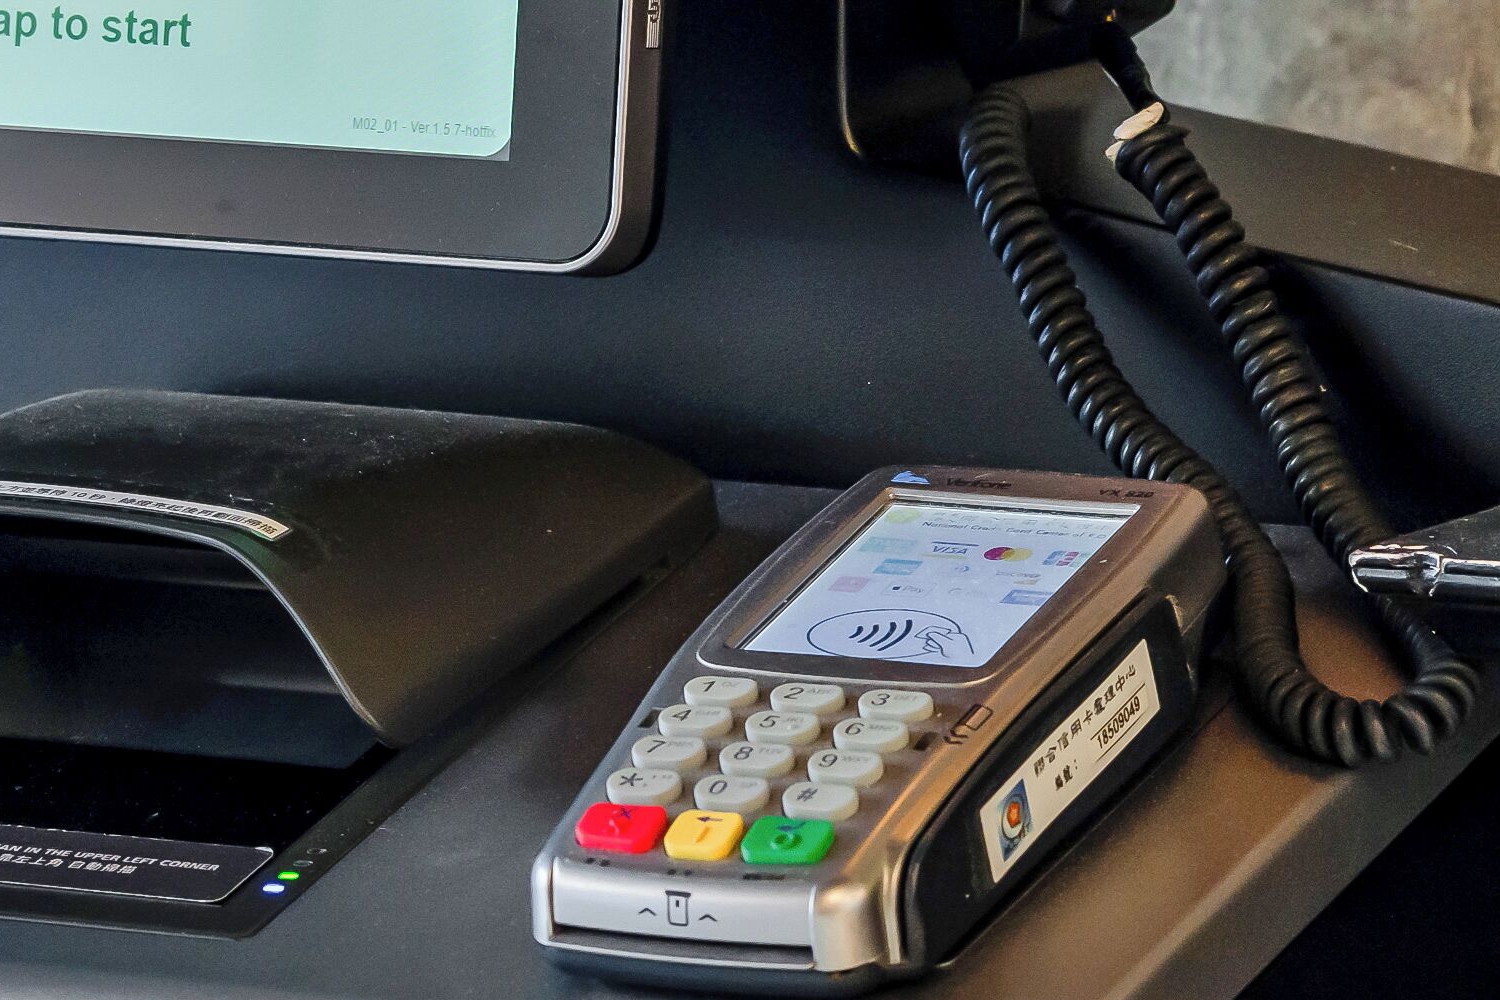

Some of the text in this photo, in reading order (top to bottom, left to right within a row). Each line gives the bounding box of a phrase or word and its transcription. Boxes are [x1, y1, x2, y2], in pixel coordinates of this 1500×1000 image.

[51, 5, 88, 40] to
[101, 9, 192, 48] start
[352, 116, 398, 134] M02_01
[930, 544, 969, 556] VISA
[699, 680, 717, 692] 1
[783, 686, 805, 700] 2
[870, 693, 891, 706] 3
[671, 709, 692, 721] 4
[758, 714, 781, 728] 5
[844, 722, 865, 735] 6
[1097, 695, 1142, 750] 18509049
[646, 739, 667, 753] 7
[733, 746, 753, 760] 8
[818, 753, 838, 768] 9
[708, 779, 729, 794] 0
[24, 845, 41, 855] IN
[44, 848, 73, 858] THE
[72, 850, 123, 863] UPPER
[122, 855, 158, 867] LEFT
[159, 859, 221, 873] CORNER
[67, 860, 138, 875] 自動掃描
